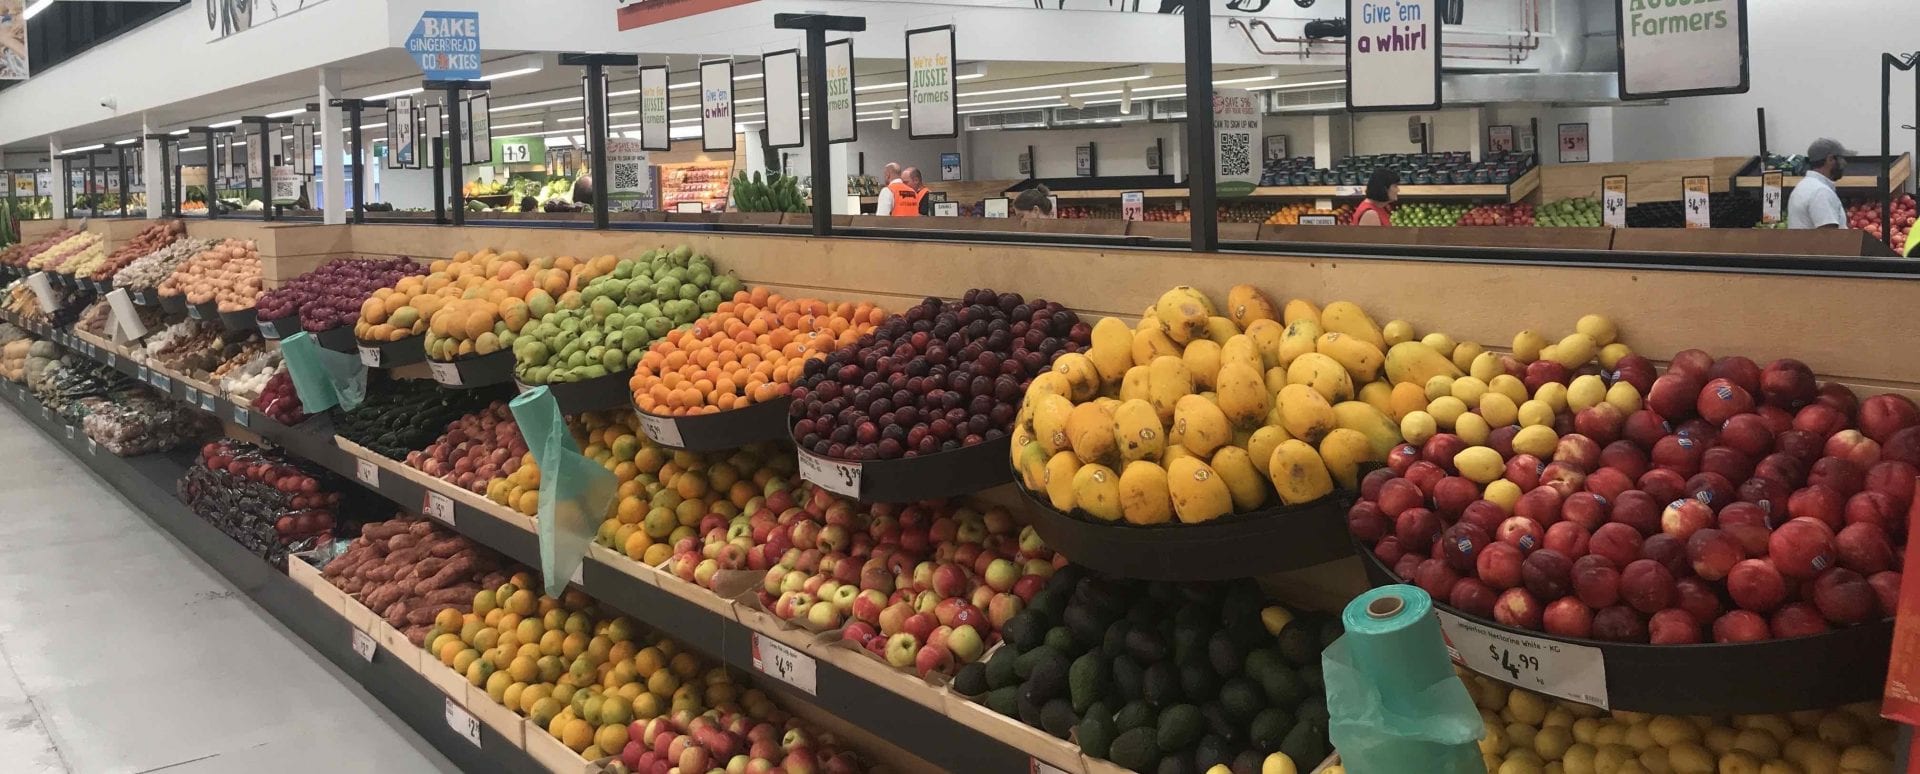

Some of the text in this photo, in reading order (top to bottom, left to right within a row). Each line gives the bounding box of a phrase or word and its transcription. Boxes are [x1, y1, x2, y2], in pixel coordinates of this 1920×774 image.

[1363, 3, 1391, 24] Give
[421, 17, 476, 38] BAKE
[1631, 10, 1728, 37] Farmers
[1358, 23, 1427, 53] a whirl
[913, 53, 947, 68] We're for
[838, 65, 847, 77] for
[913, 67, 948, 88] AUSSIE
[827, 77, 848, 97] SSIE
[643, 97, 665, 112] AUSSIE
[705, 90, 716, 102] Give
[913, 89, 949, 104] Farmers
[705, 102, 729, 119] a whirl
[828, 98, 849, 112] rmers
